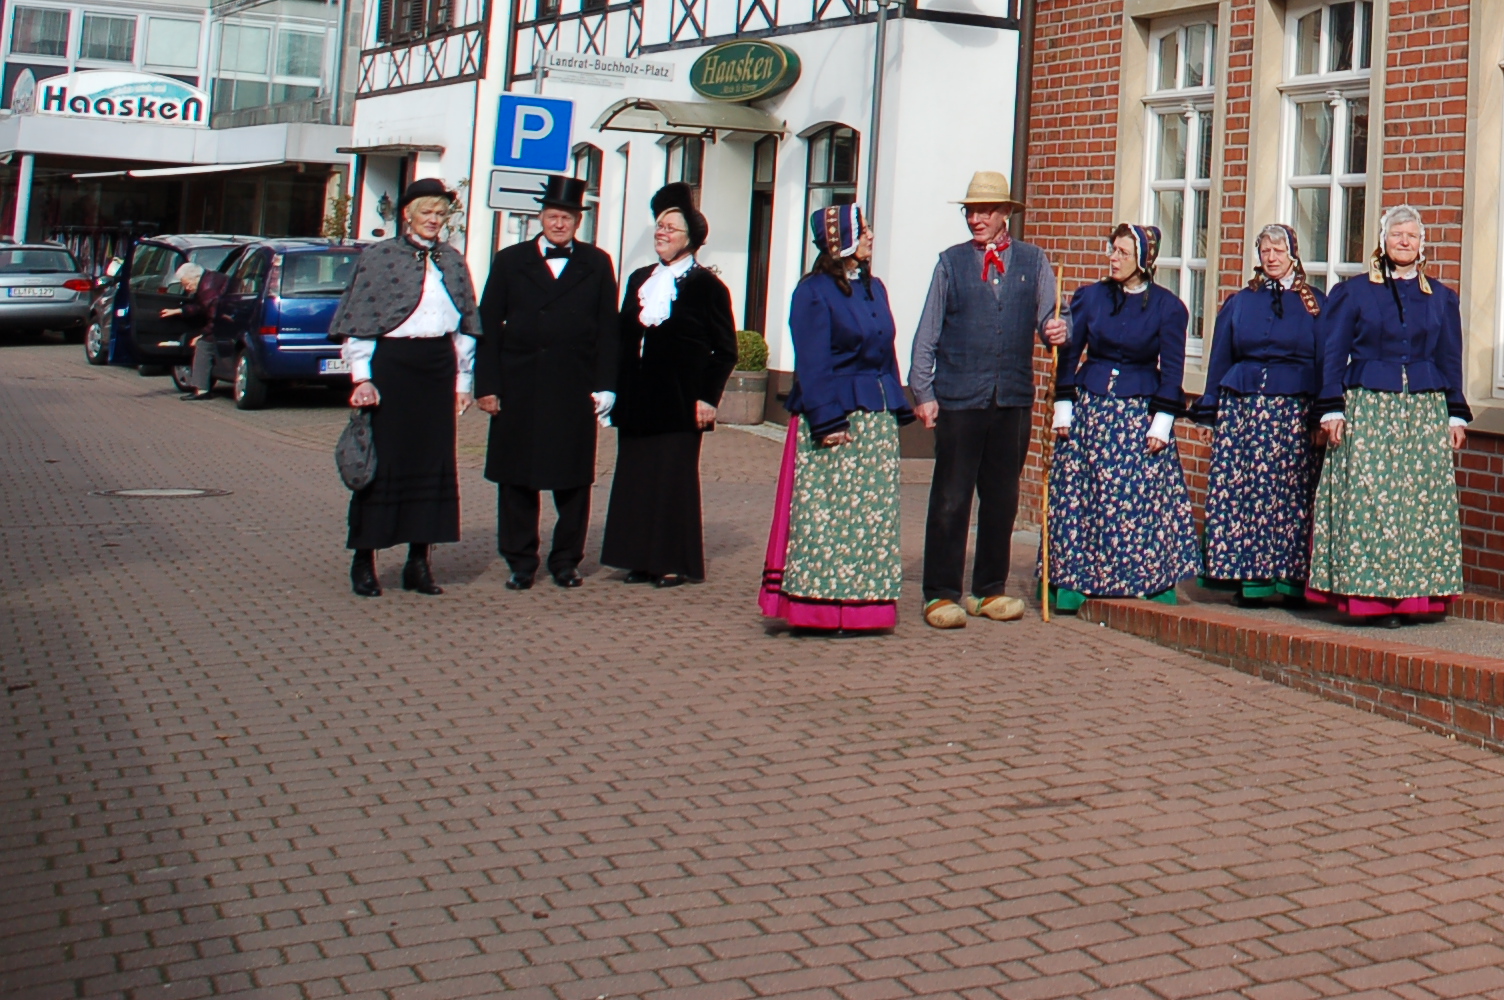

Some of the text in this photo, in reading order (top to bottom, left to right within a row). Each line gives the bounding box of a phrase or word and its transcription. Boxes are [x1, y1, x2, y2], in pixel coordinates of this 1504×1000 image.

[550, 54, 669, 78] Landrat-Buchholz-Platz
[702, 46, 774, 85] Haasken
[43, 85, 204, 122] Haasken
[510, 104, 555, 159] P
